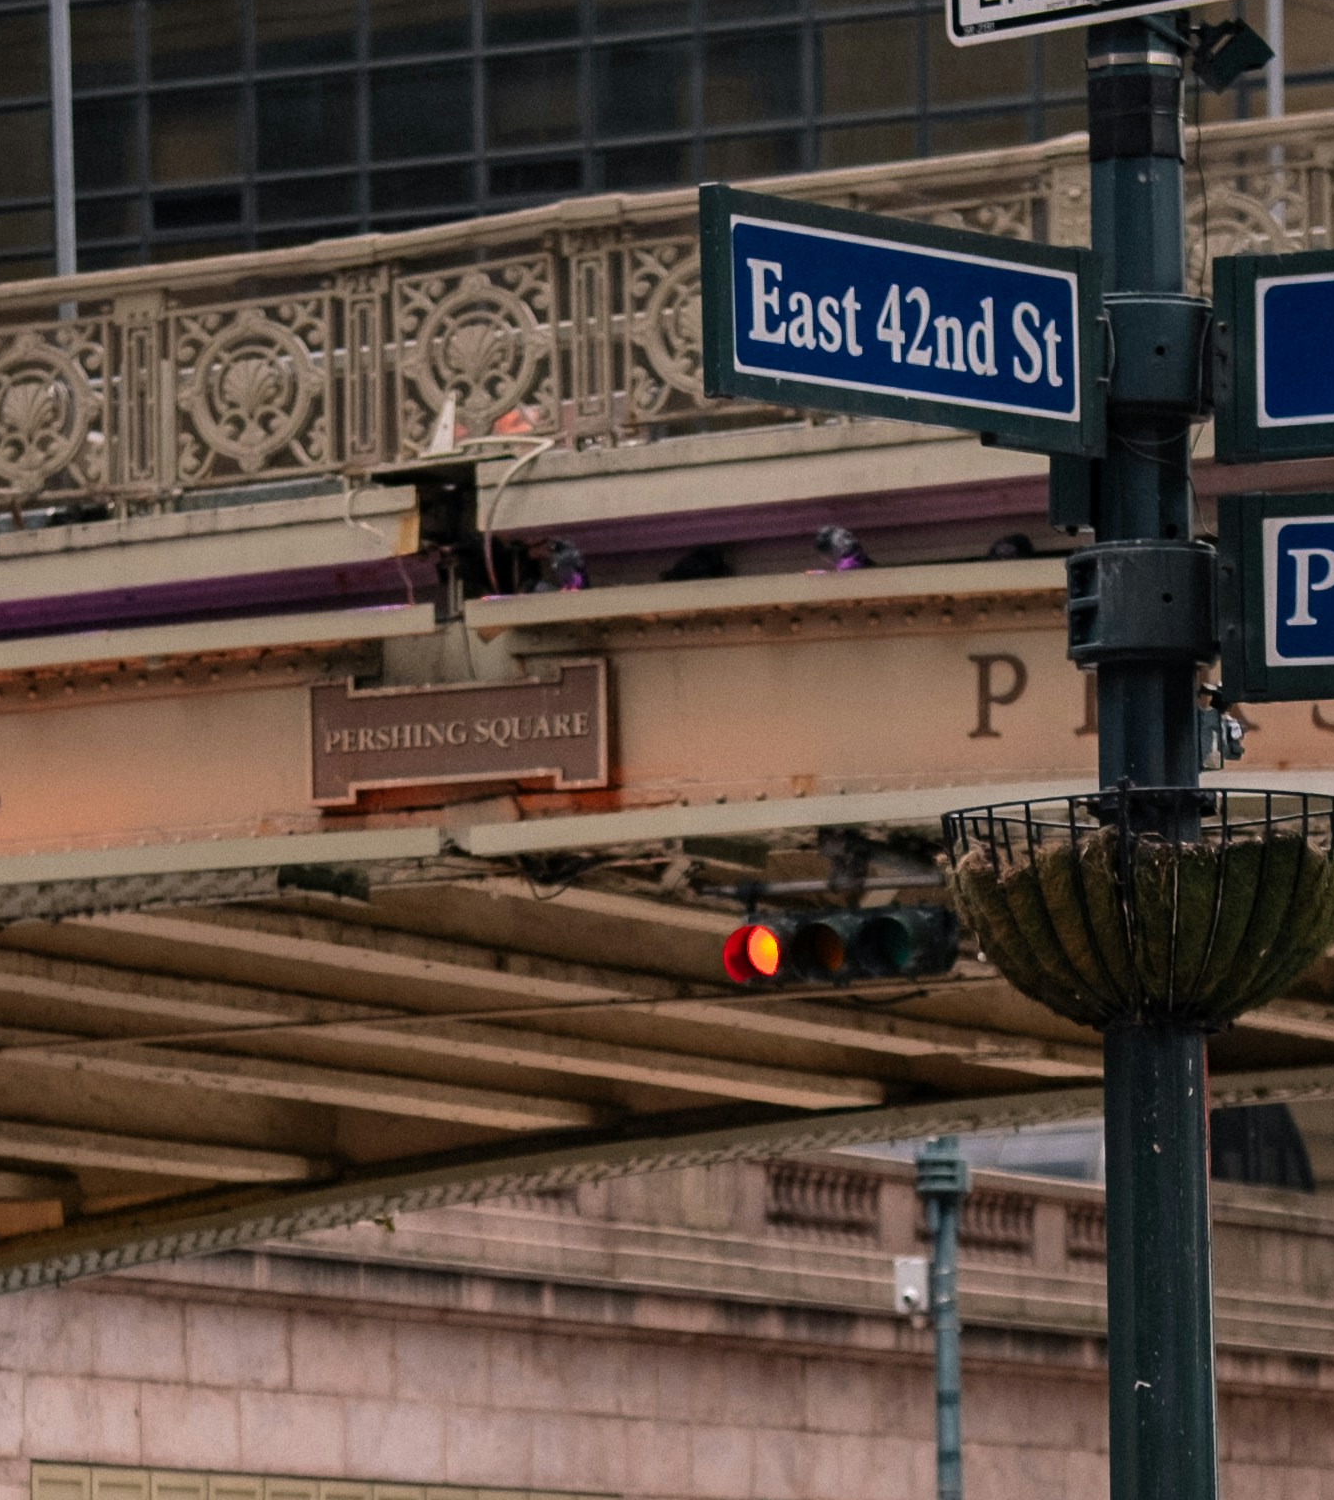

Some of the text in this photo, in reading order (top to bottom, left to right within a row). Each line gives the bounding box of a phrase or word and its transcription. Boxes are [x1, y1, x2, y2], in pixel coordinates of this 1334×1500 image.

[746, 257, 1063, 390] East 42nd St
[325, 711, 590, 753] PERSHING SQUARE
